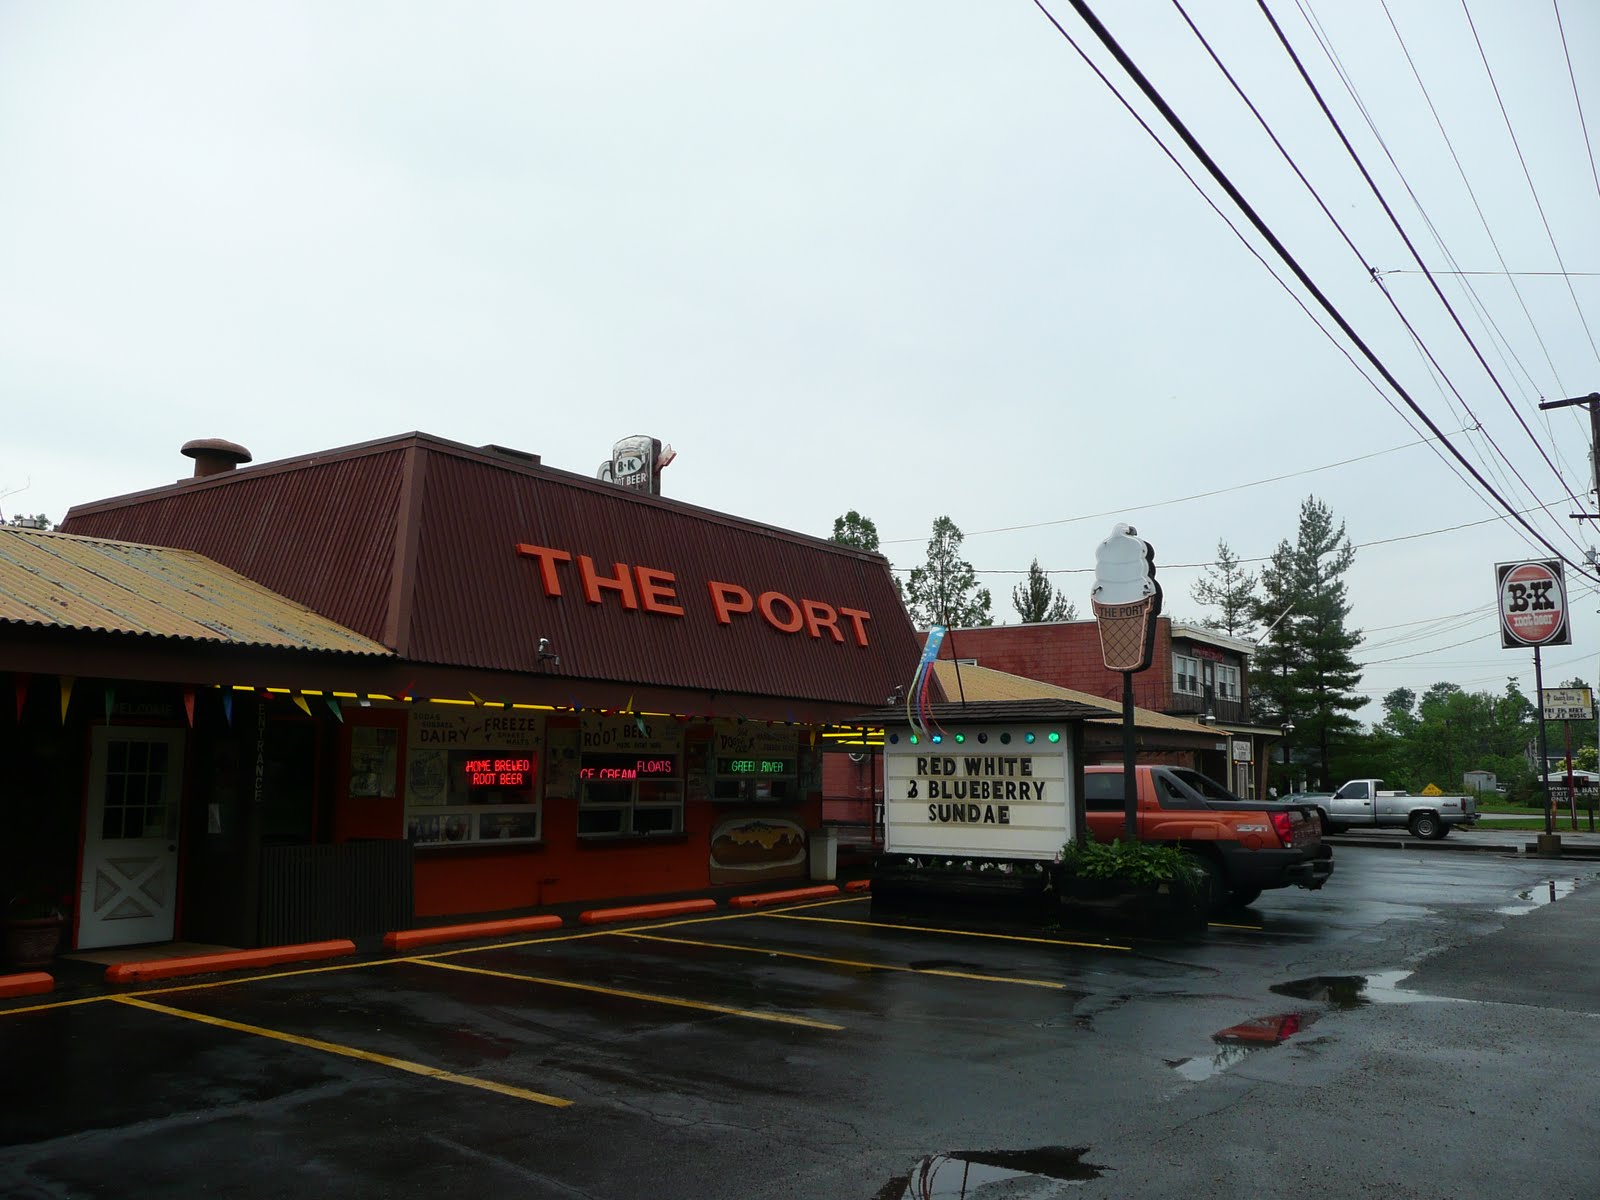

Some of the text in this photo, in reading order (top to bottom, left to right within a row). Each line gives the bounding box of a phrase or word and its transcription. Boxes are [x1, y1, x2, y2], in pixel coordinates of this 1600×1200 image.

[626, 473, 647, 486] BEER
[515, 543, 871, 648] THE PORT
[1099, 603, 1145, 618] THE PORT
[420, 717, 537, 743] DAIRY FREEZE
[584, 728, 617, 747] ROOT
[255, 703, 266, 801] ENTRANCE
[465, 760, 530, 773] HOME BREWED
[599, 768, 637, 779] CREAM
[637, 760, 672, 773] FLOATS
[761, 760, 784, 773] RIVER
[916, 757, 1033, 777] RED WHITE
[472, 773, 523, 785] ROOT BEER
[928, 780, 1046, 801] BLUEBERRY
[928, 803, 1011, 825] SUNDAE
